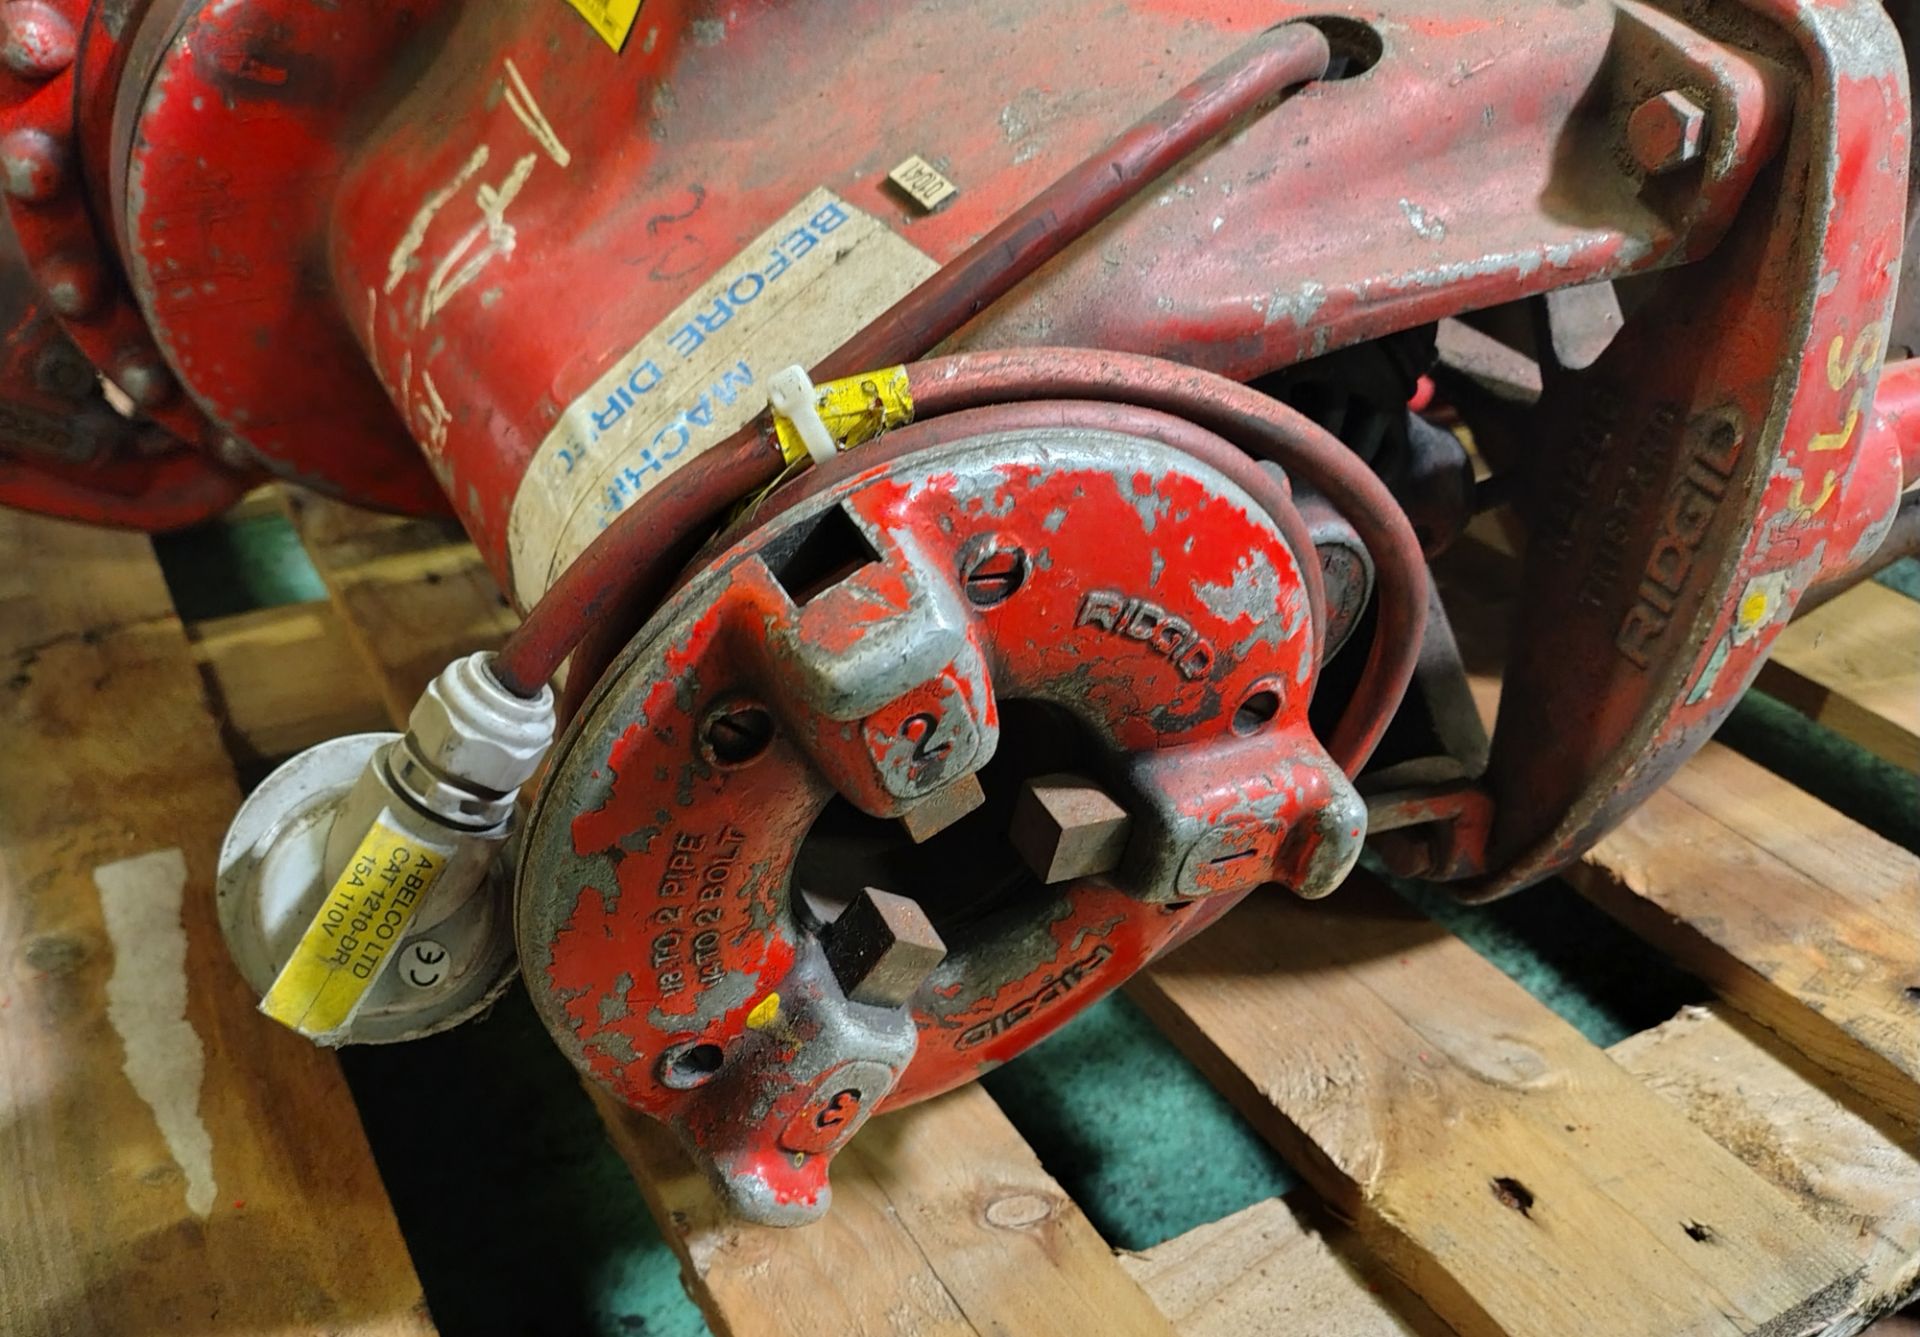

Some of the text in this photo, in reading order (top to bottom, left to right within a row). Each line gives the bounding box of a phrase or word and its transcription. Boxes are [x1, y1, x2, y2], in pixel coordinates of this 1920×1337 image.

[667, 203, 848, 358] BEFORE
[1615, 402, 1746, 670] RIDGID
[1074, 590, 1216, 682] RIDGID
[901, 712, 953, 762] 2
[321, 855, 377, 938] 15A 110V
[659, 830, 707, 897] PIPE
[700, 824, 746, 901] BOLT
[330, 847, 410, 966] CAT 1210-DR
[352, 854, 433, 979] A-BELCO LTD
[654, 906, 684, 926] 2
[694, 906, 722, 927] 2
[652, 928, 682, 968] TO
[695, 931, 721, 967] TO
[816, 1088, 862, 1128] 3
